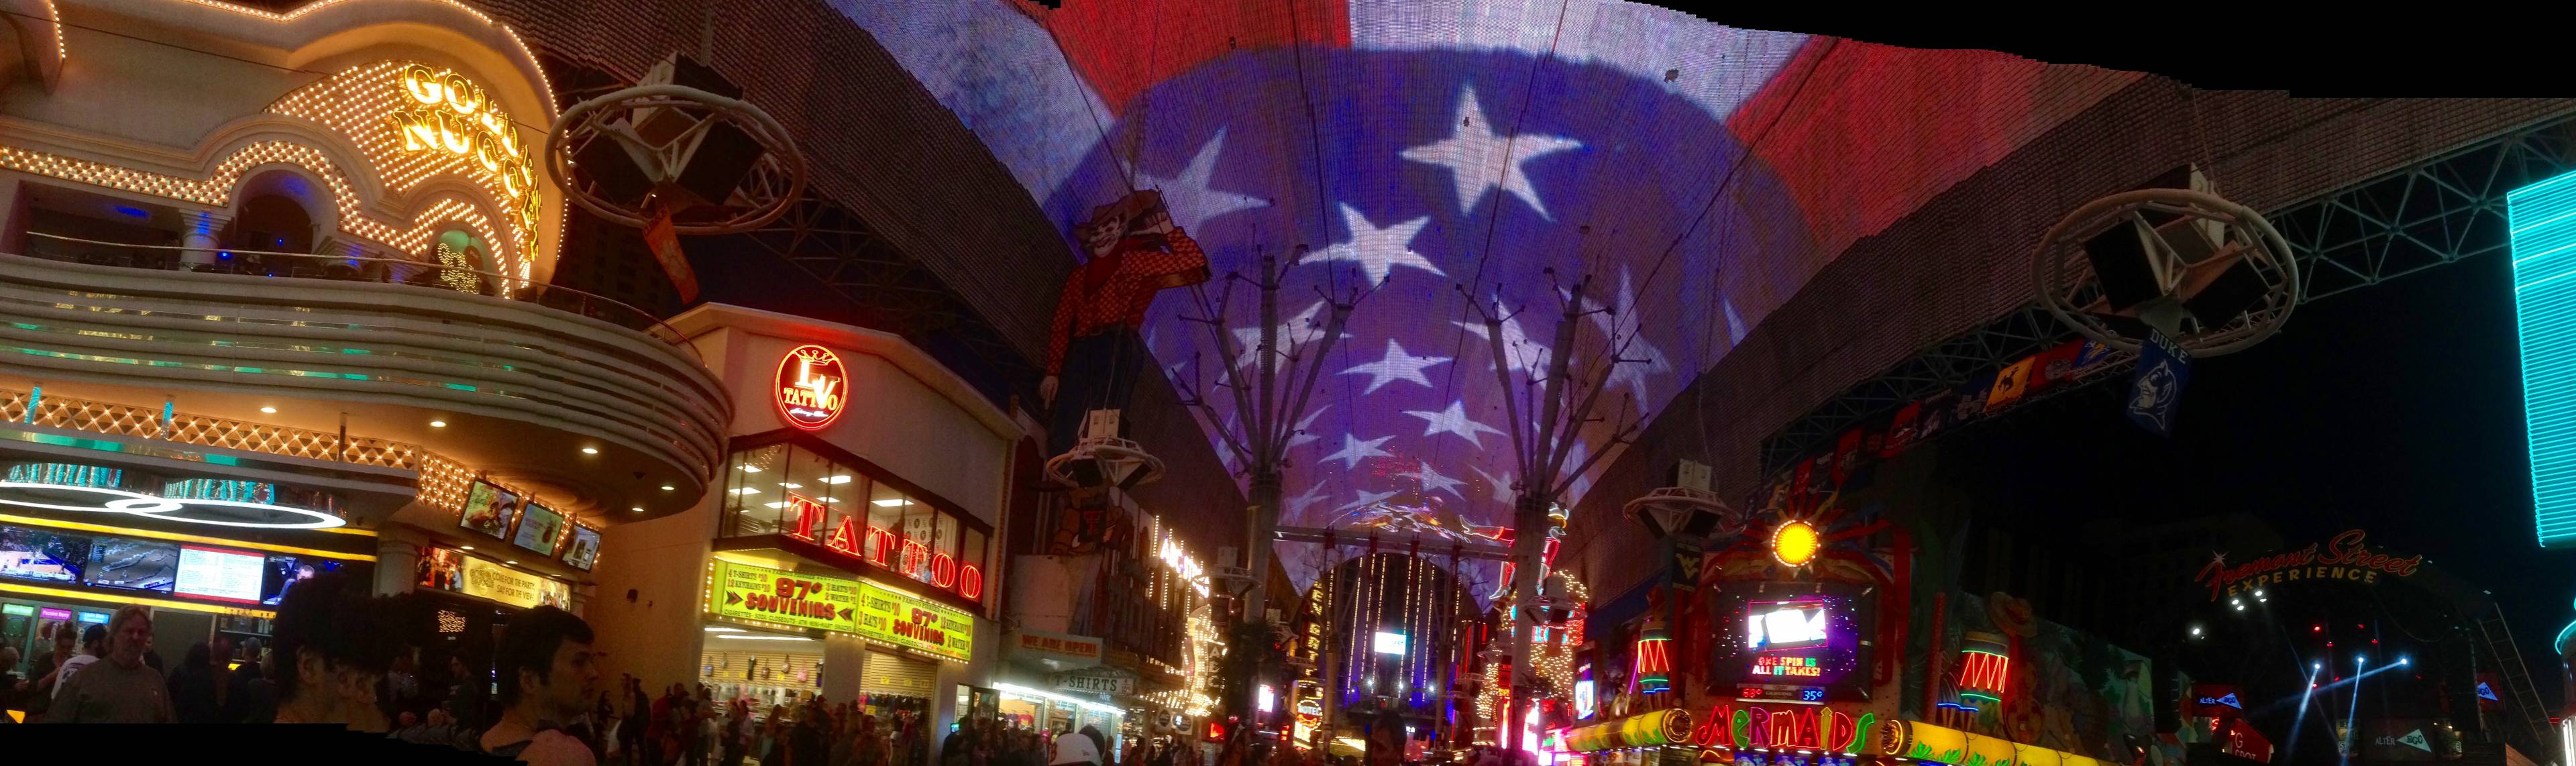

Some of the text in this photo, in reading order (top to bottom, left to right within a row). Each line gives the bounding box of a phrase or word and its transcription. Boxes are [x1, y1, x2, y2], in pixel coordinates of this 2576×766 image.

[2149, 328, 2188, 364] DUKE
[794, 359, 841, 409] LV
[784, 387, 839, 411] TATTO
[788, 492, 981, 598] TATTOO
[2195, 529, 2422, 602] Fremont Street
[504, 576, 514, 586] FOR
[2227, 566, 2377, 597] EXPERIENCE
[506, 587, 515, 596] FOR
[745, 592, 837, 620] SOUVENIRS
[892, 618, 946, 647] SOUVENIRS
[1022, 634, 1038, 646] WE
[1041, 637, 1062, 650] ARE
[1752, 665, 1821, 676] ALL IT TAKES!
[1780, 657, 1804, 666] SPIN
[1054, 675, 1117, 692] T-SHIRTS
[2235, 732, 2243, 749] G
[2375, 736, 2396, 745] ALTER
